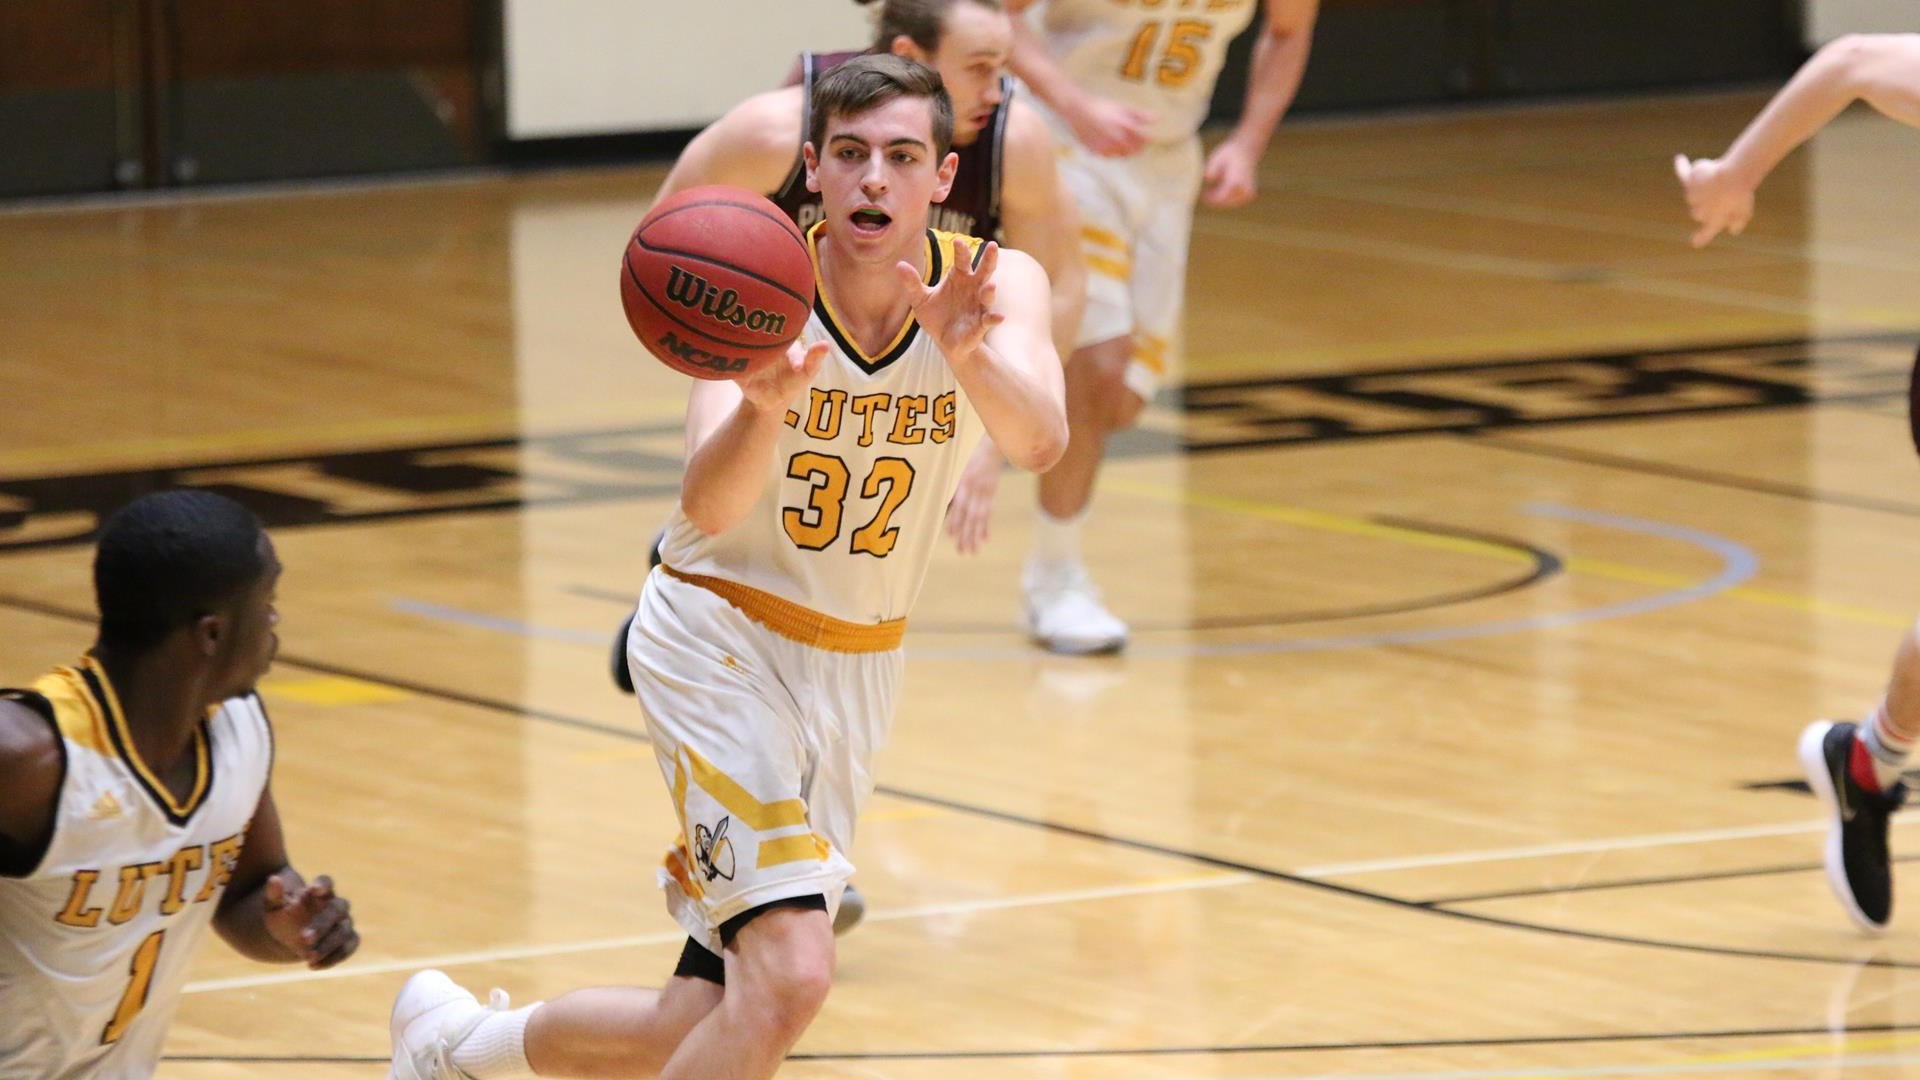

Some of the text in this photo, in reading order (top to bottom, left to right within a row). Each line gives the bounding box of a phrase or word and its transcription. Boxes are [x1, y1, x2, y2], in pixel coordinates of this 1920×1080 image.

[1119, 20, 1212, 87] 15
[665, 264, 787, 336] Wilson
[658, 331, 750, 373] NCAA
[783, 388, 956, 447] UTES
[782, 450, 916, 558] 32
[55, 820, 251, 928] LUTE
[99, 928, 167, 1045] 1
